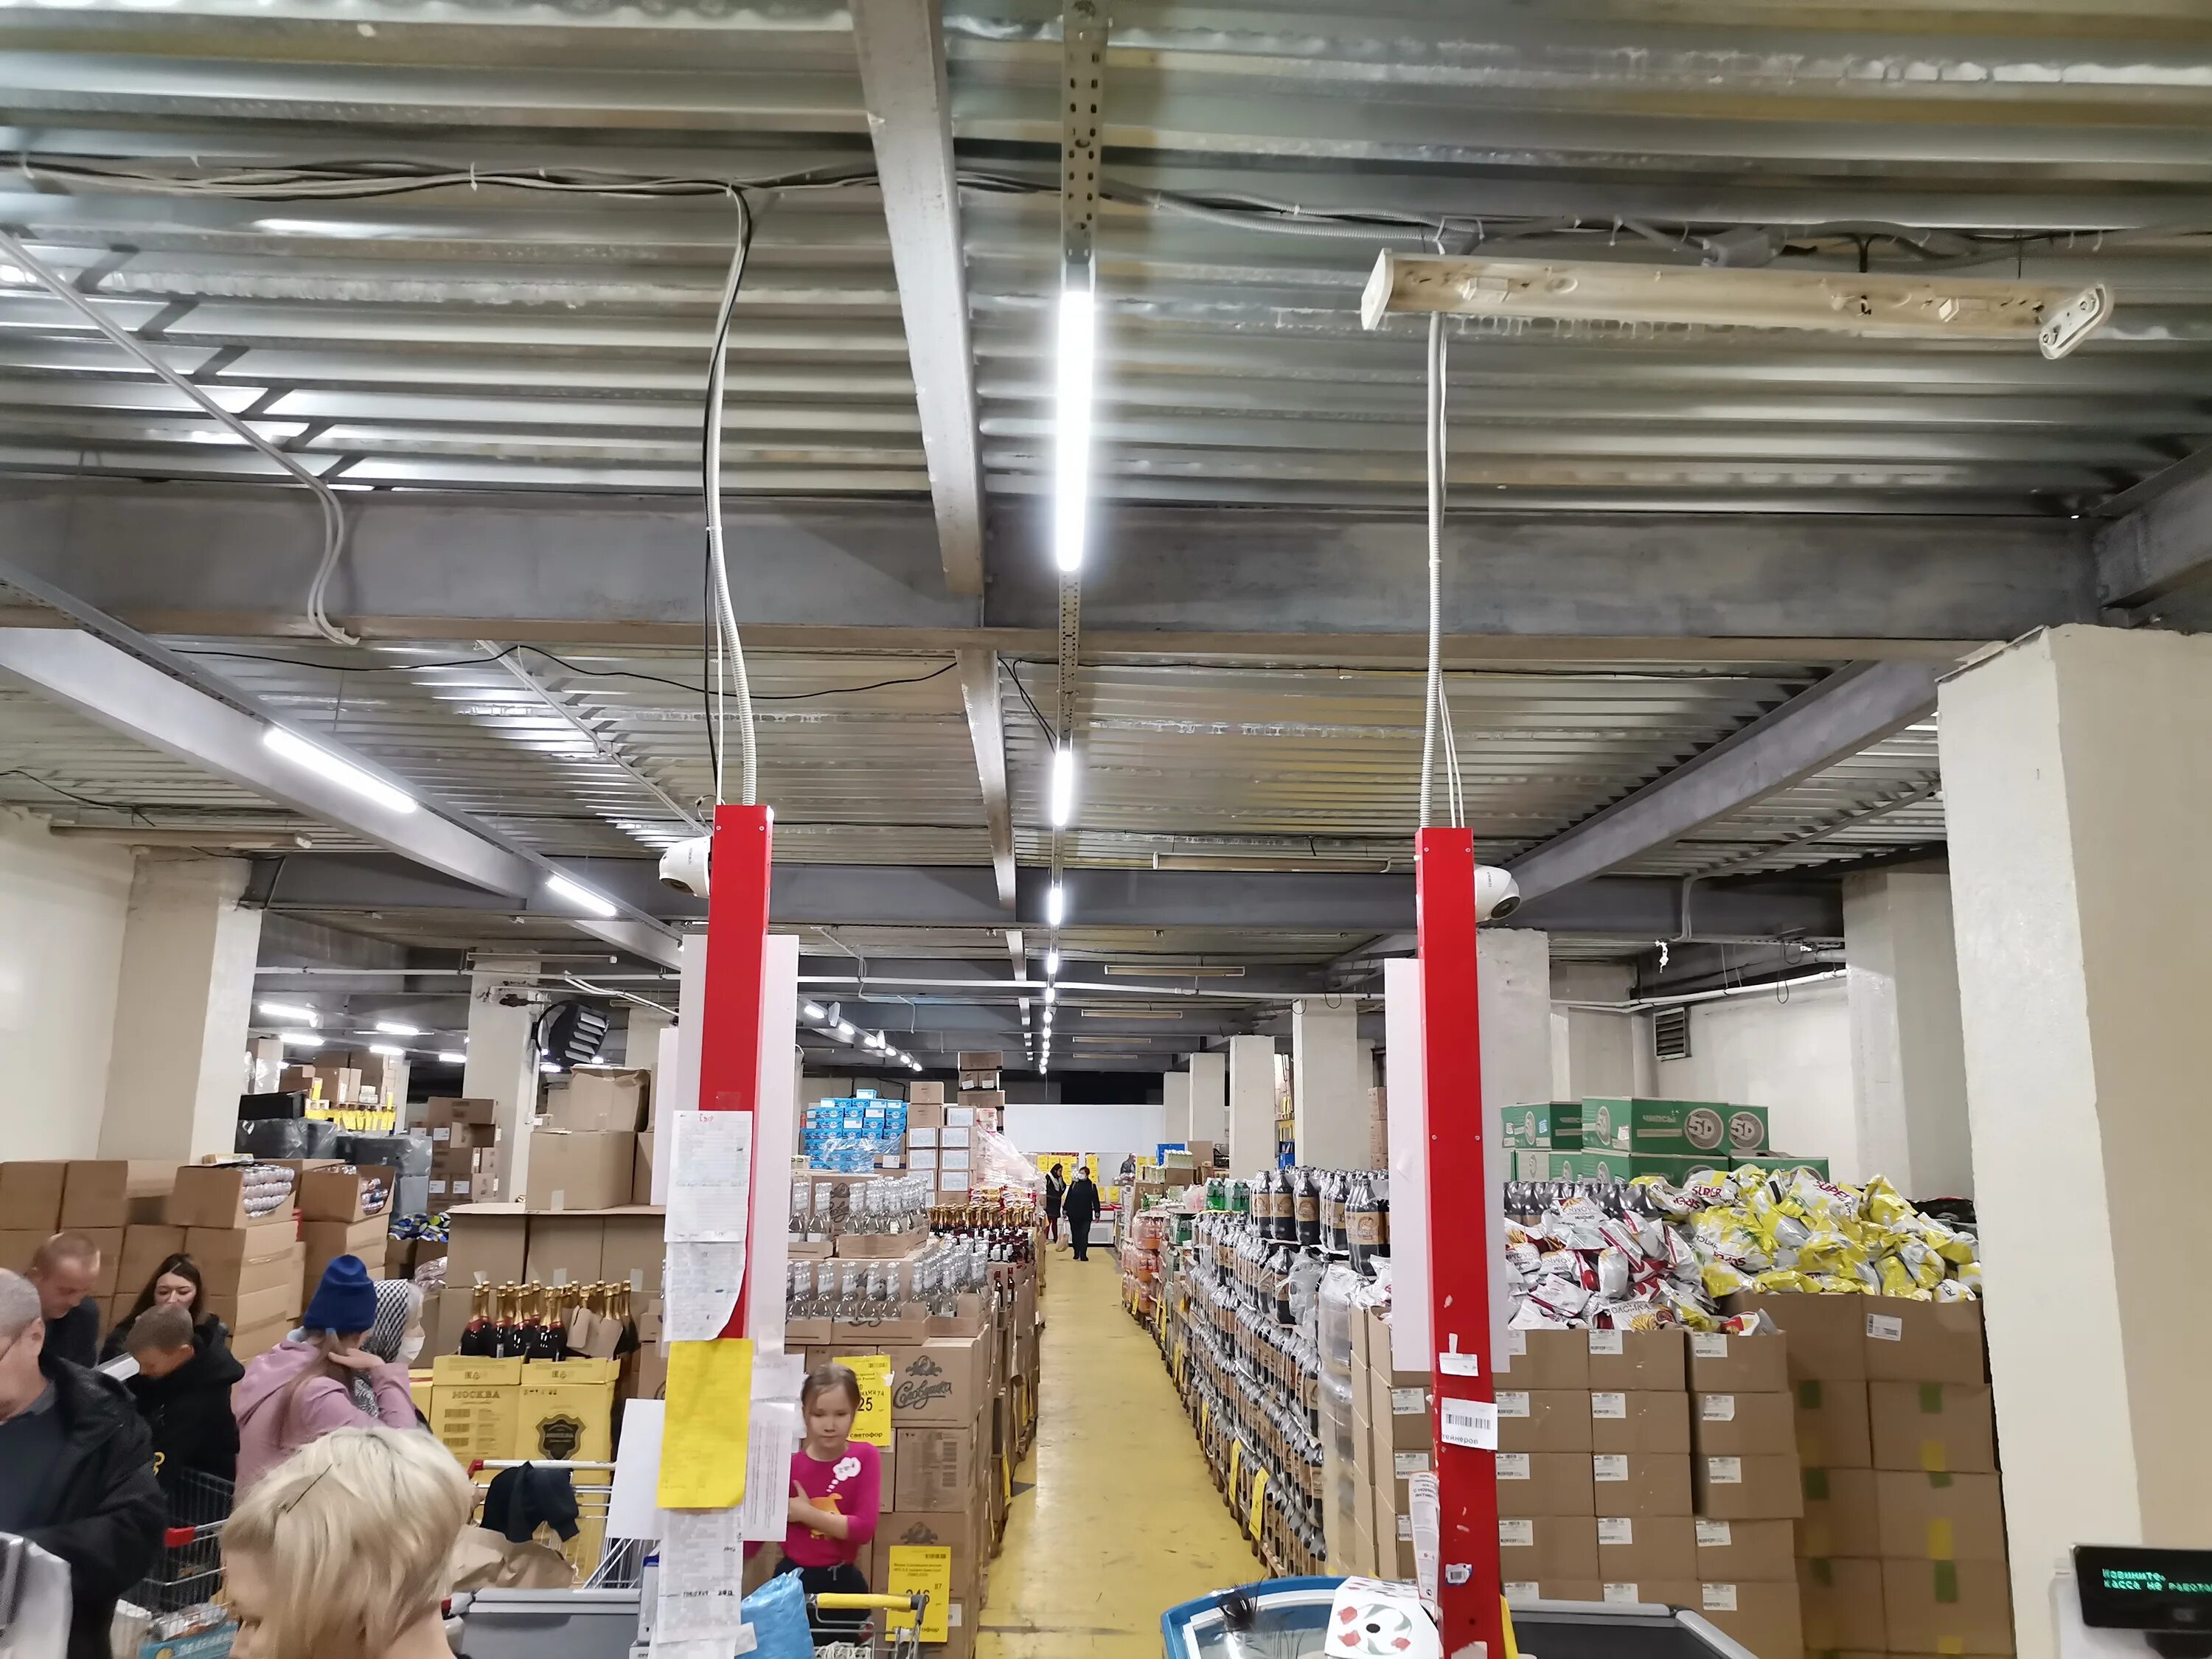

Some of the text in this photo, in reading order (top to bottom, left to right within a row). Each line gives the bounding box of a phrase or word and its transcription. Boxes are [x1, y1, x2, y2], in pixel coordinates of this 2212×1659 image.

[1688, 1115, 1714, 1139] 5D
[1731, 1119, 1756, 1141] 5D
[452, 1391, 500, 1399] МОСКВА
[2146, 1581, 2163, 1590] не
